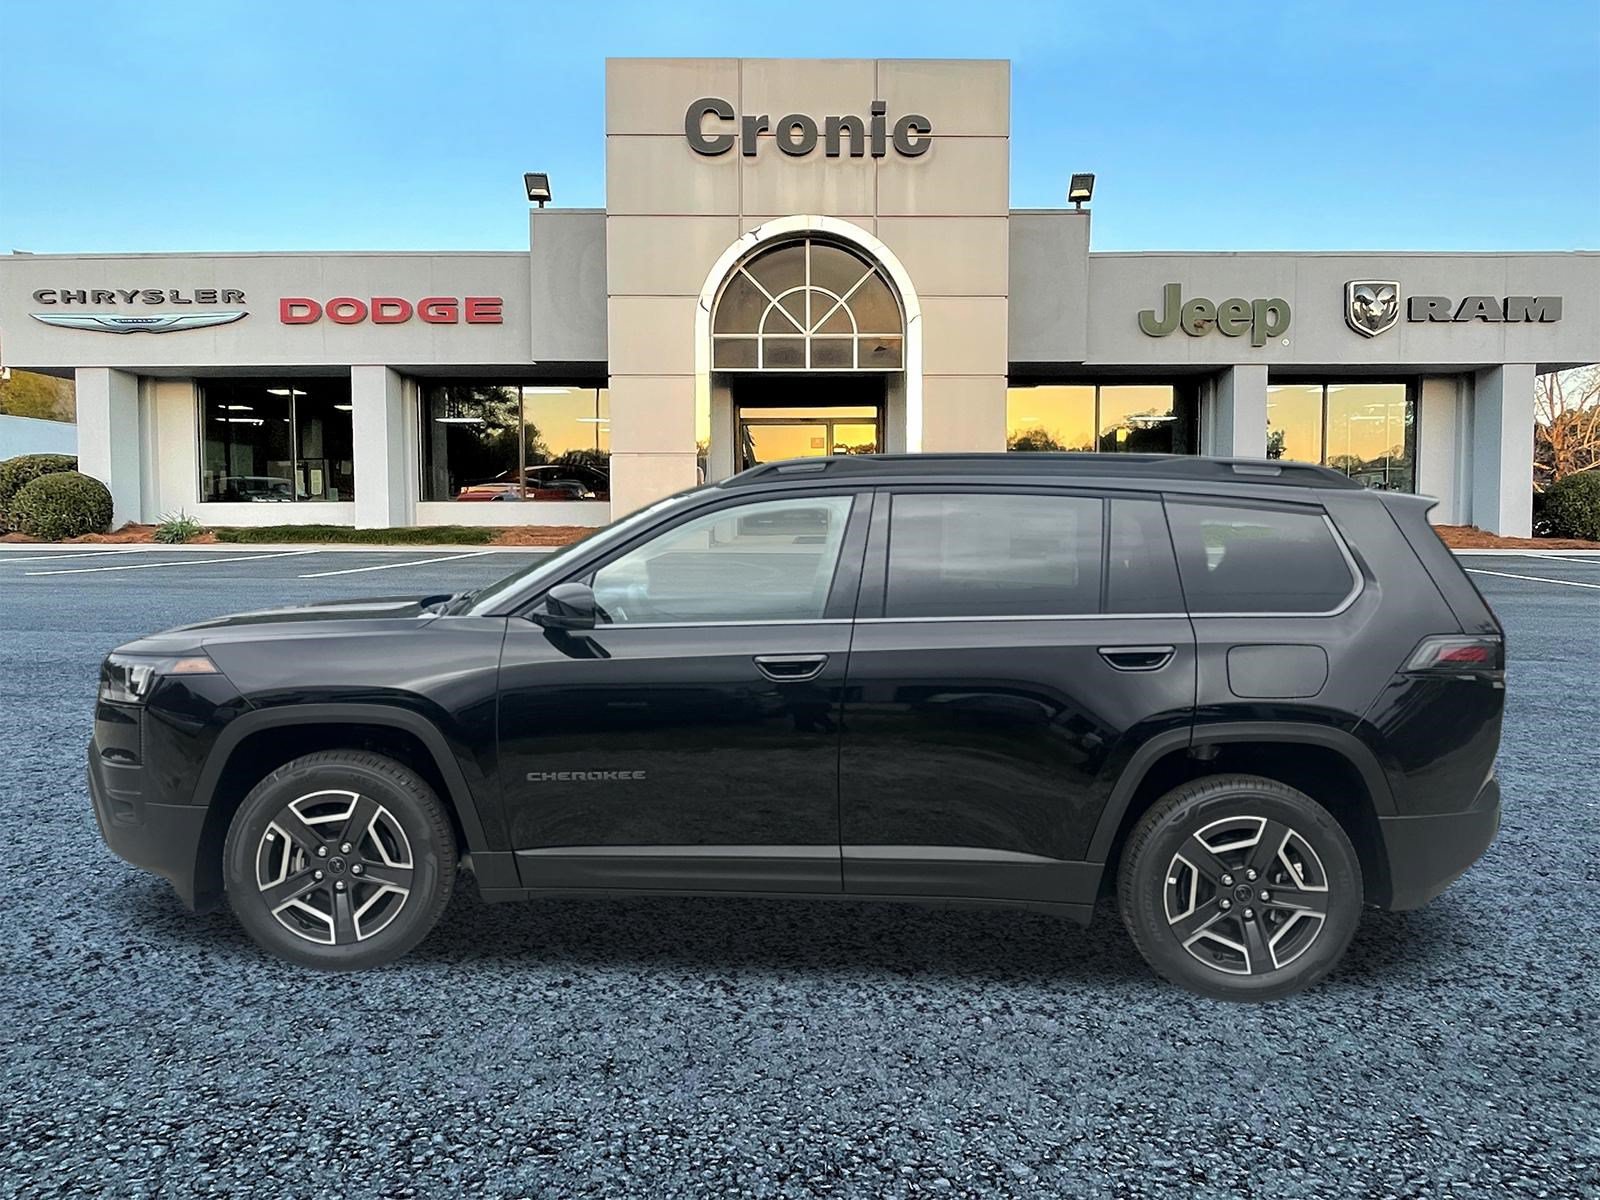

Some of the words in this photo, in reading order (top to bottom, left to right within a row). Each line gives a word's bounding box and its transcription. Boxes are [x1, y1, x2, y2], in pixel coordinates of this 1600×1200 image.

[684, 97, 932, 158] Cronic
[32, 288, 246, 304] CHRYSLER
[1407, 296, 1563, 323] RAM
[279, 297, 503, 324] DODGE
[1137, 283, 1291, 348] Jeep
[526, 770, 647, 781] CHEROKEE
